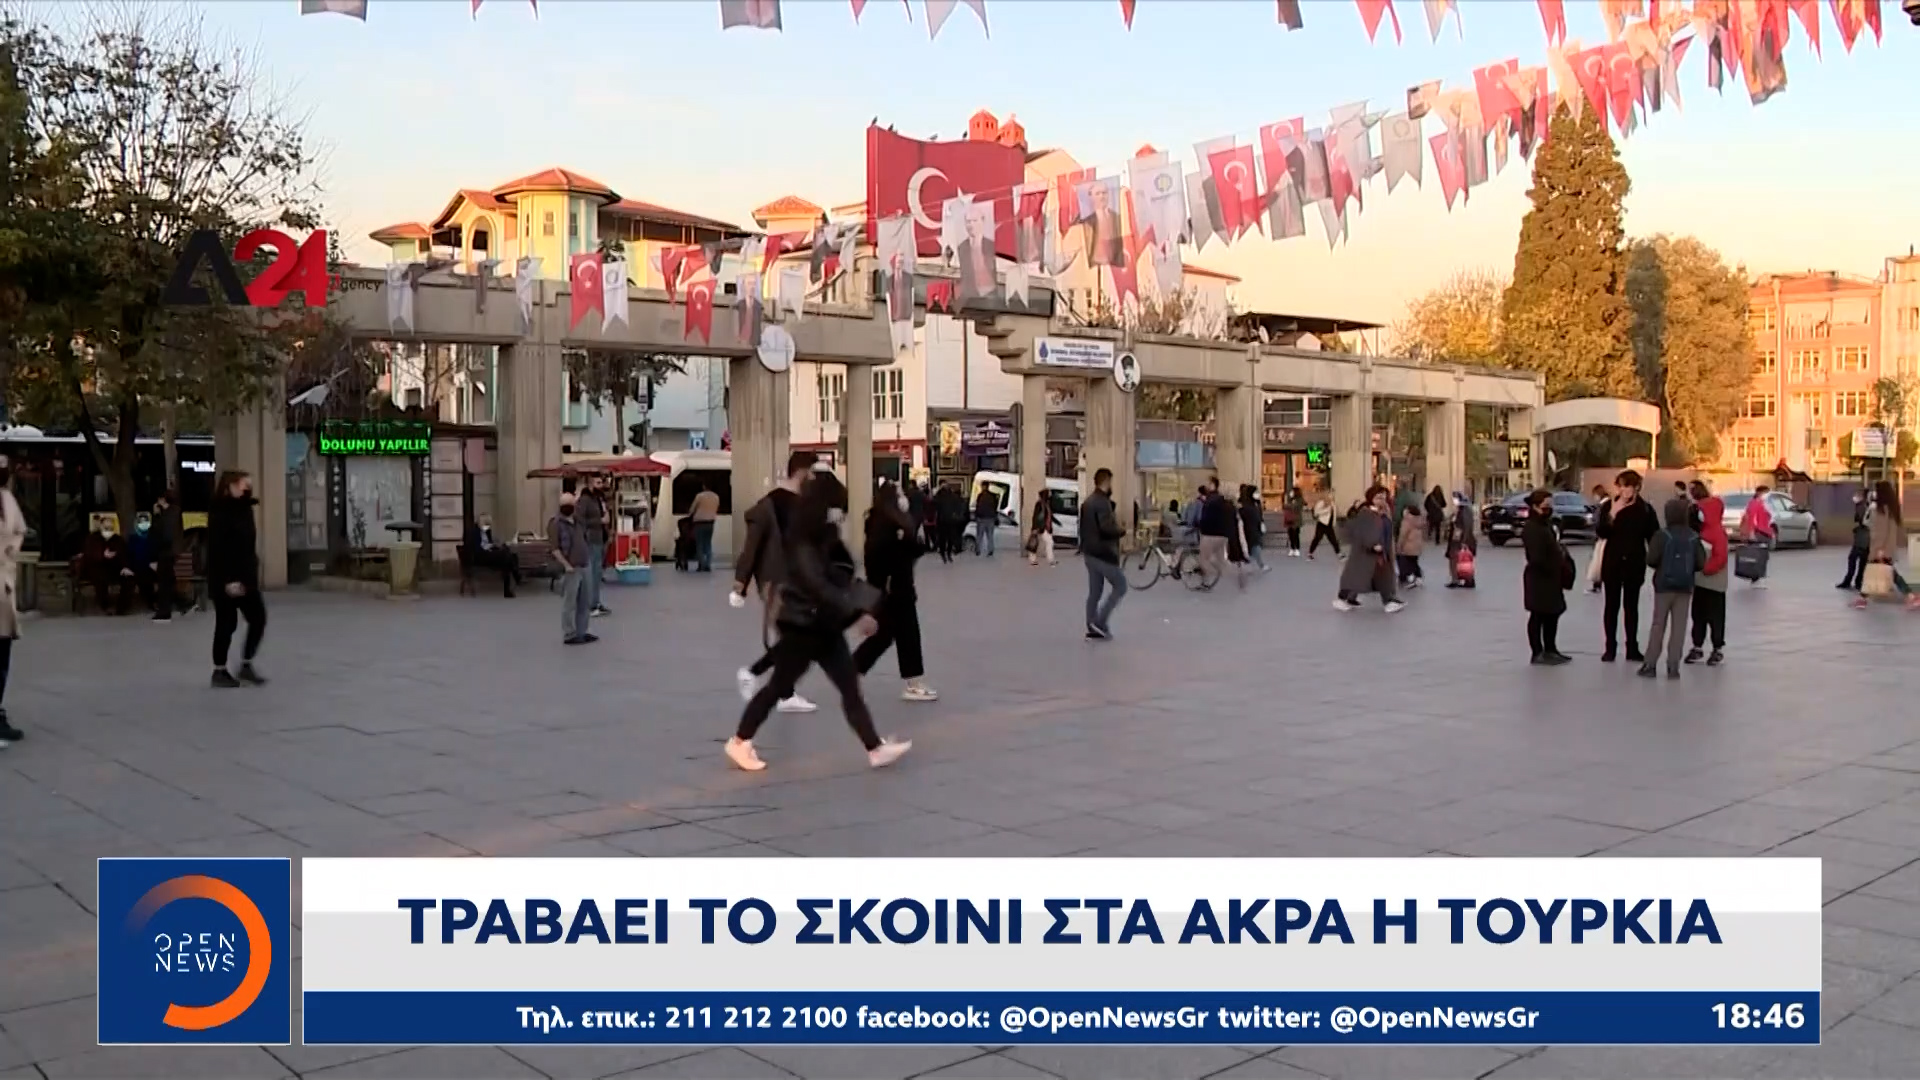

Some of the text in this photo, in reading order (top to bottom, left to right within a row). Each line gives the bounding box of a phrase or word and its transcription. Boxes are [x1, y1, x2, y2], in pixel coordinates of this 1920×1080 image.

[321, 439, 429, 450] DOLUMU YAPILIR
[1307, 450, 1323, 463] WC
[1510, 447, 1528, 462] WC
